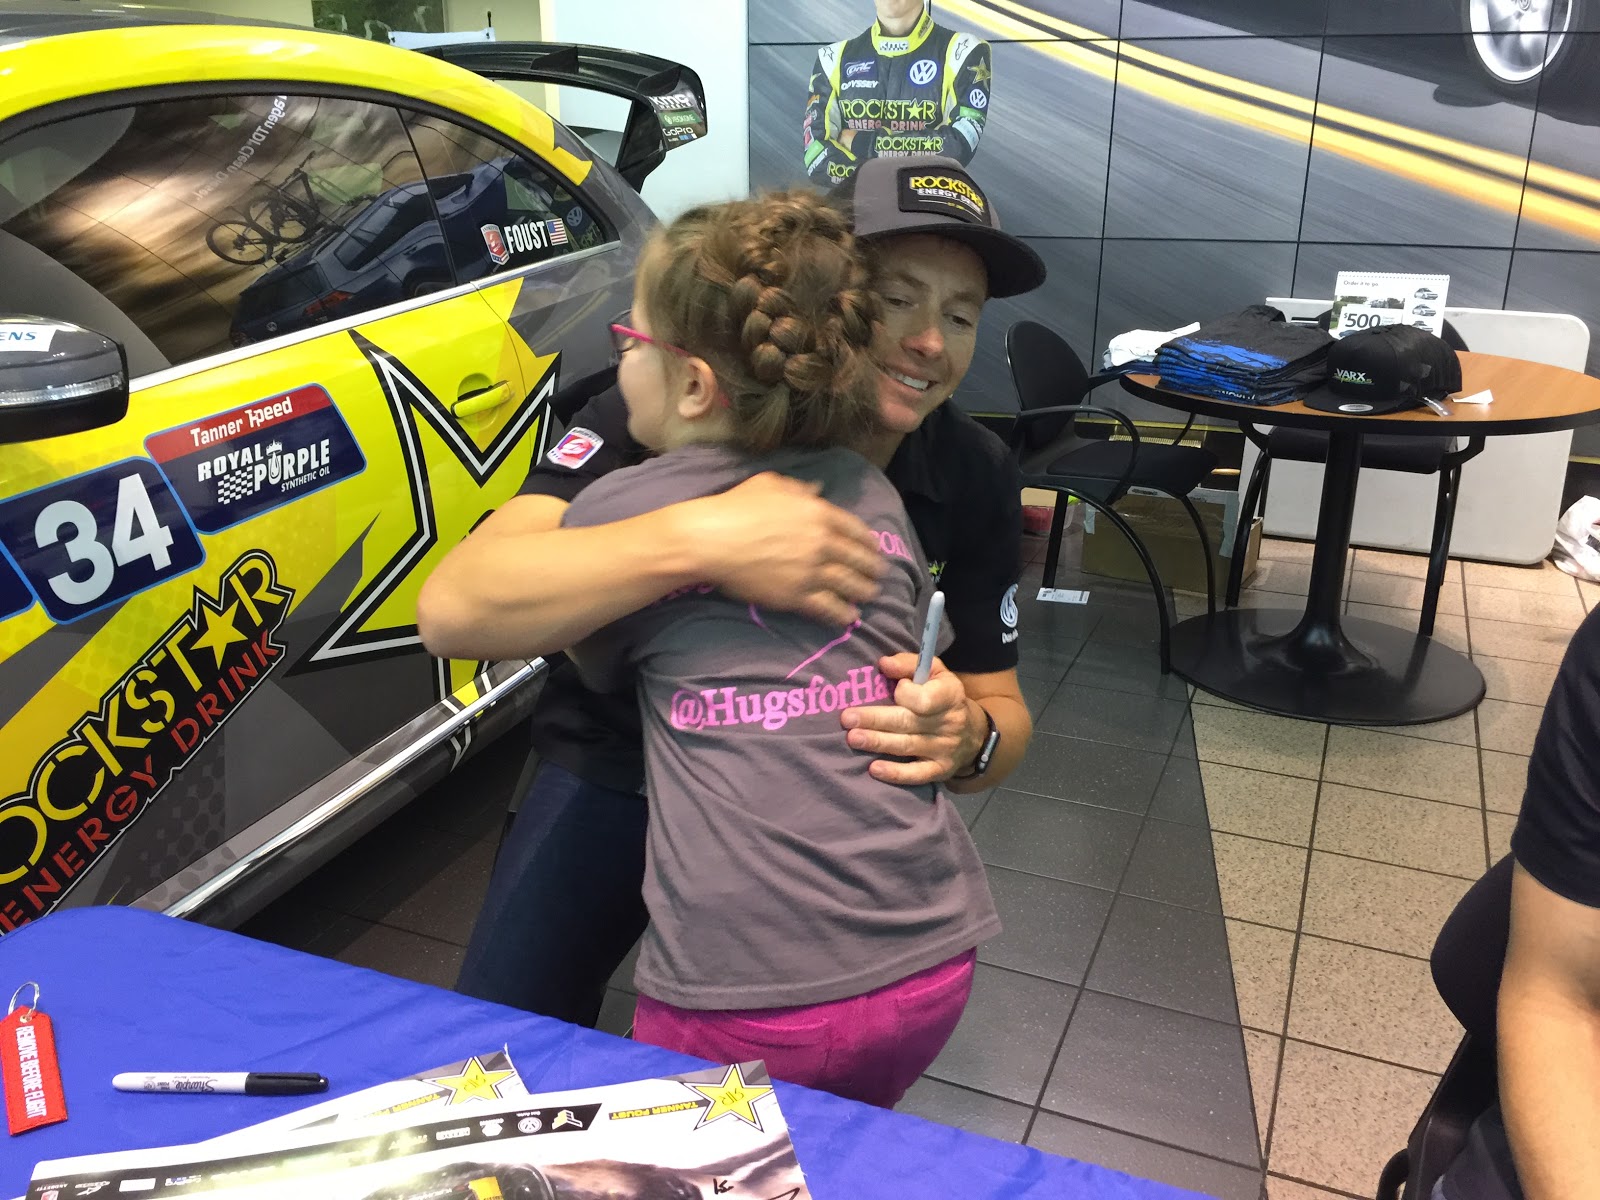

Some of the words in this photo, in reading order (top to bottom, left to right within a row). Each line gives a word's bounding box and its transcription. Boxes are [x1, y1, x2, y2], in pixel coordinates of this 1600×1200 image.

[663, 127, 694, 137] GoPro
[890, 120, 926, 131] DRINK
[875, 136, 944, 151] ROCKSTAR
[917, 188, 958, 200] ENERGY
[504, 222, 549, 254] FOUST
[1335, 367, 1367, 382] VARX
[190, 416, 243, 448] Tanner
[197, 443, 264, 482] ROYAL
[253, 438, 330, 492] PURPLE
[280, 471, 317, 493] SYNTHETIC
[319, 466, 331, 478] OIL
[35, 473, 174, 605] 34
[0, 558, 285, 885] OCKSTAR
[0, 754, 159, 932] ENERGY
[170, 629, 279, 754] DRINK
[15, 1025, 38, 1061] REMOVE
[19, 1058, 42, 1093] BEFORE
[23, 1089, 47, 1119] FLIGHT
[611, 1108, 650, 1120] FOUST
[652, 1101, 699, 1115] TANNER
